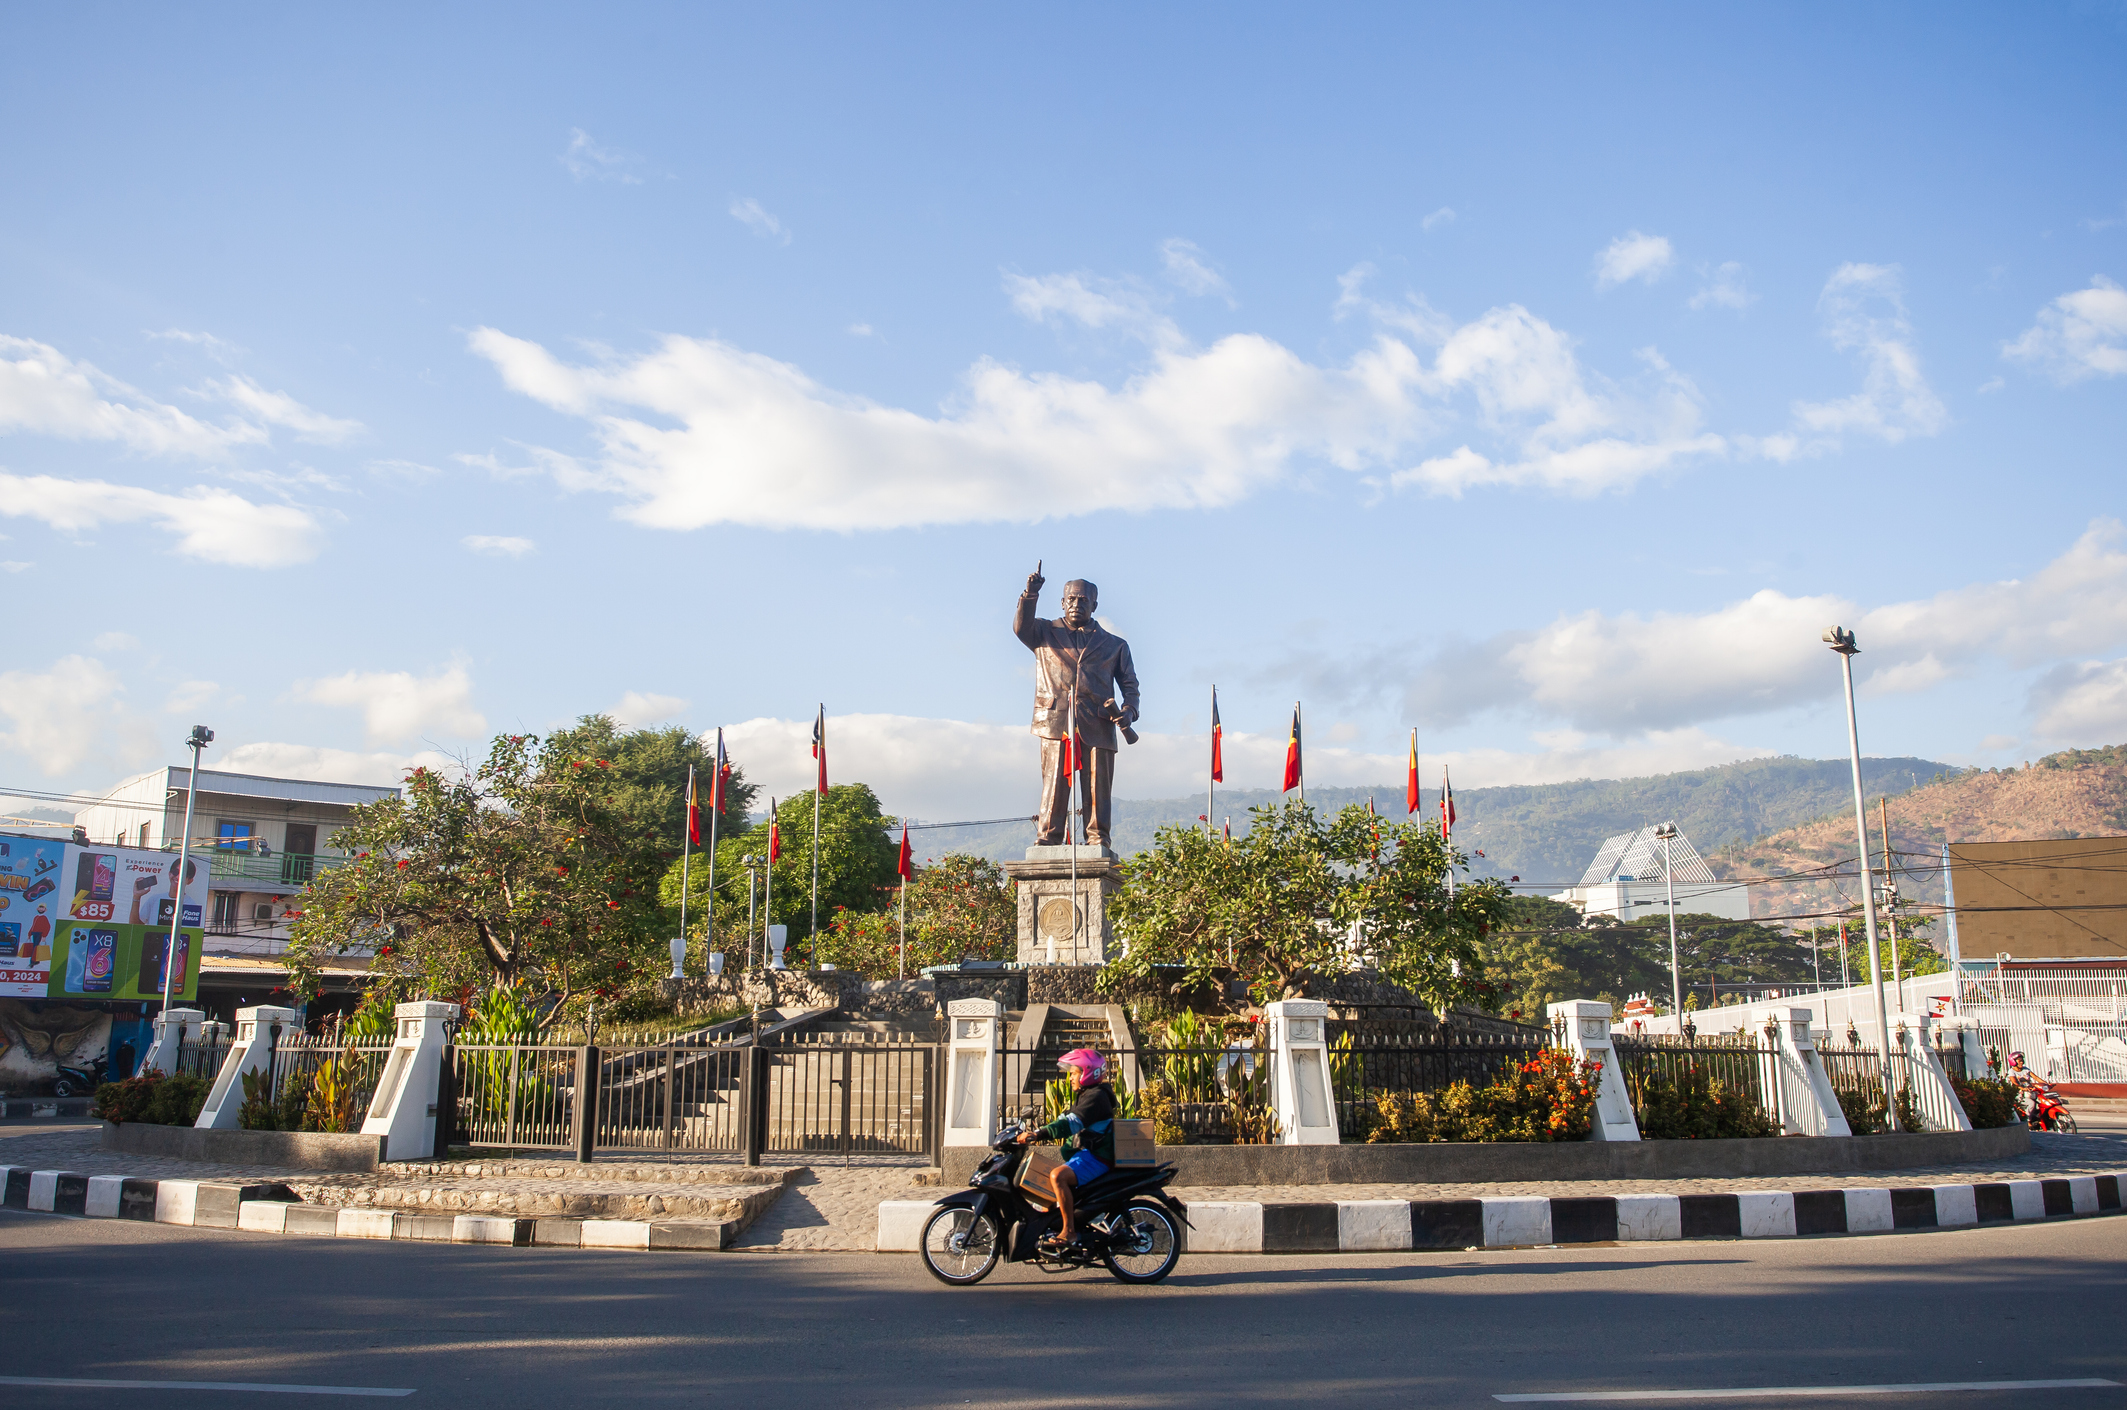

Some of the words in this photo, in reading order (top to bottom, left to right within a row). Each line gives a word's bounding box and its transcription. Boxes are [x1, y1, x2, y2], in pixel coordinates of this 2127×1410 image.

[125, 859, 164, 867] Experience
[132, 865, 162, 874] Power
[80, 903, 109, 917] $85
[94, 934, 113, 947] X8
[13, 972, 41, 981] 2024
